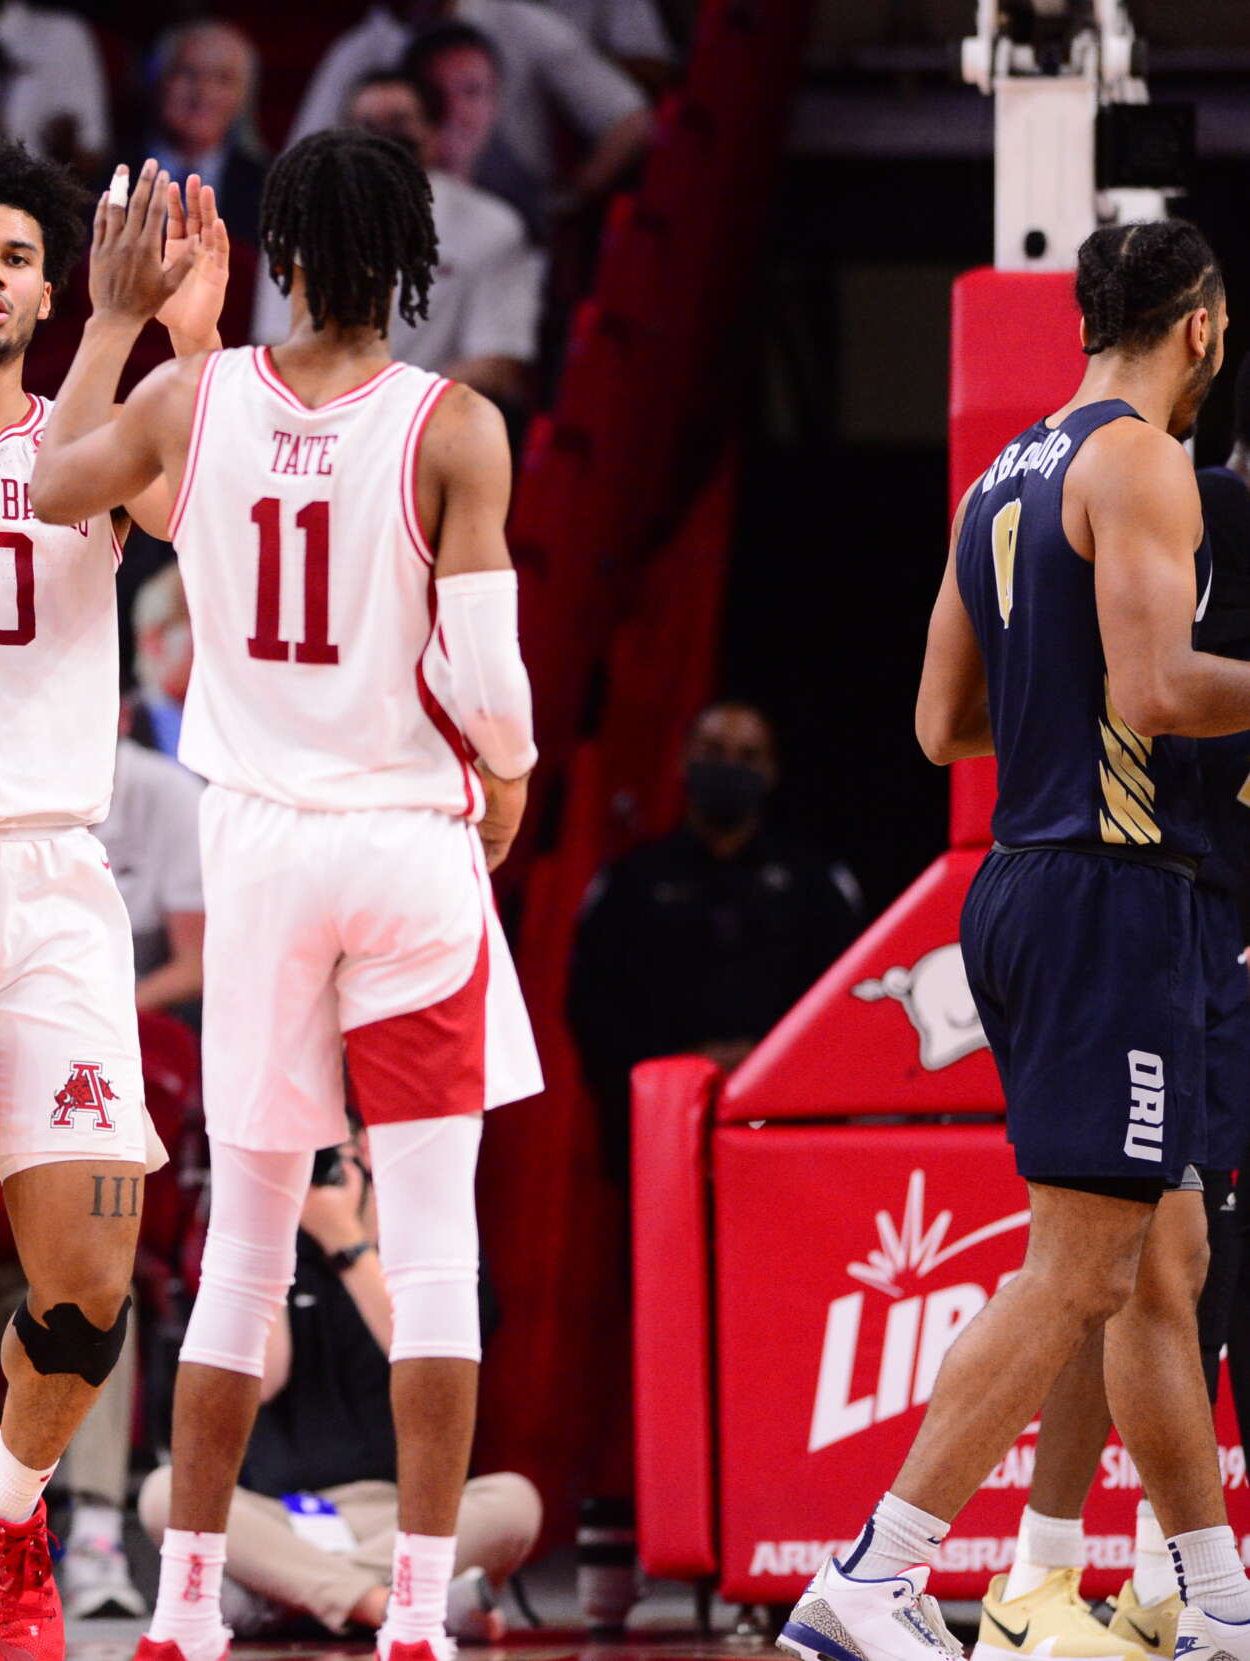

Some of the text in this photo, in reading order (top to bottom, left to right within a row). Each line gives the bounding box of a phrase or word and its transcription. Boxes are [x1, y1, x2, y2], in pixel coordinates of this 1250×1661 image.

[270, 430, 338, 475] TATE
[247, 497, 340, 665] 11
[1123, 1049, 1165, 1163] ORU
[90, 1175, 140, 1217] III
